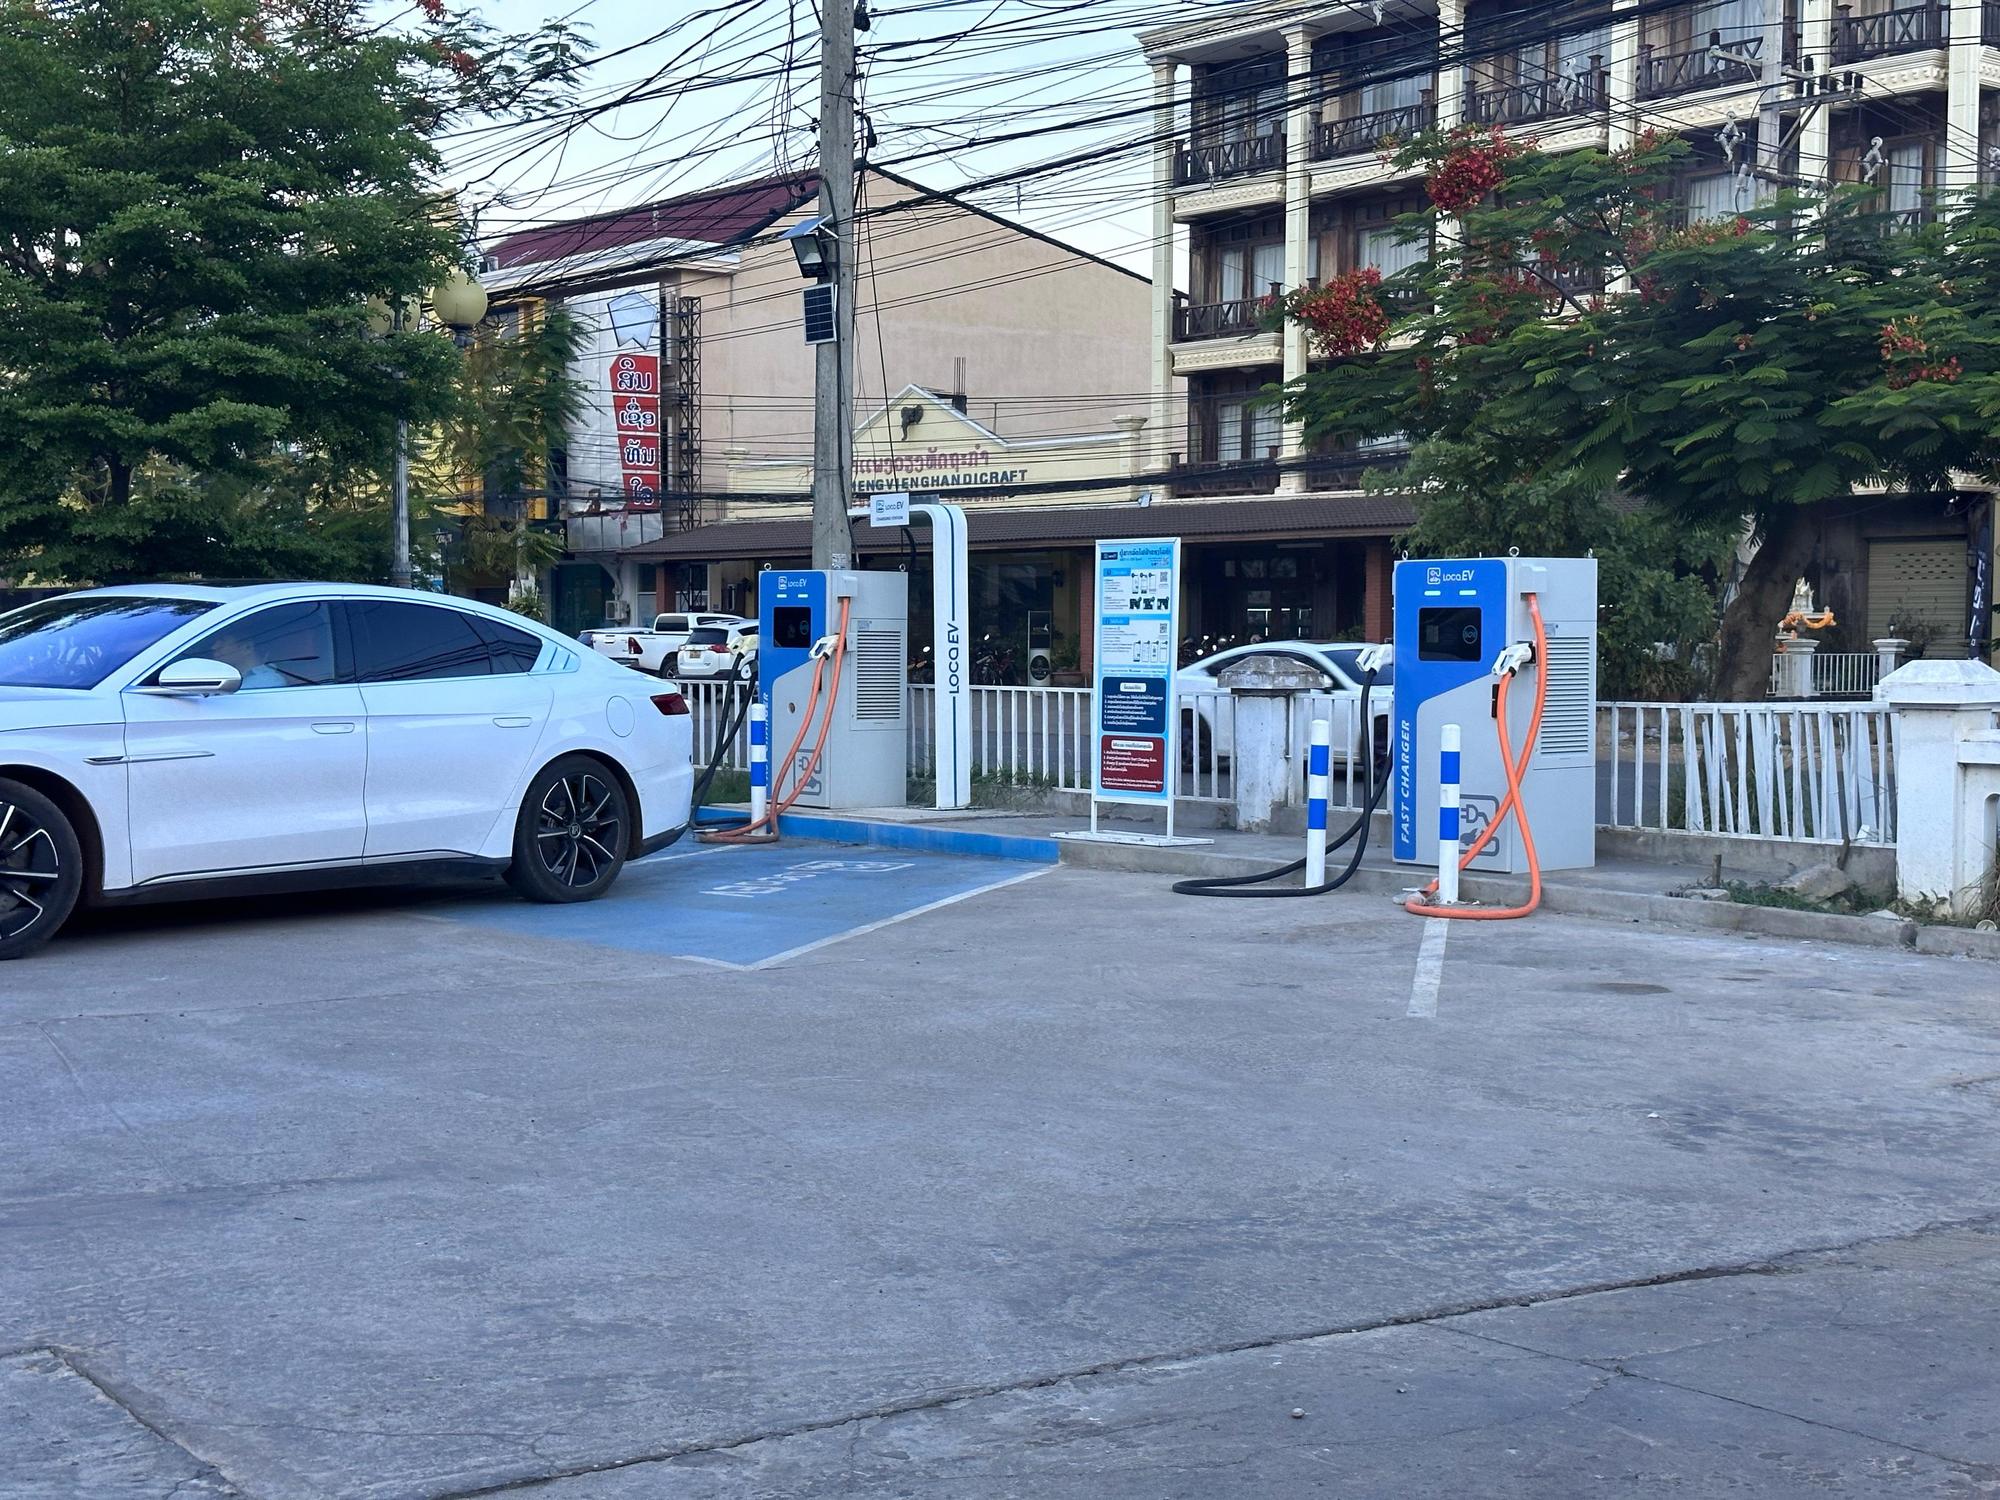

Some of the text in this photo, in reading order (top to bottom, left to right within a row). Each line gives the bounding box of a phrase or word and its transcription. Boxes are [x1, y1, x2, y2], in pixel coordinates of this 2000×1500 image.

[948, 622, 960, 694] LOCO EV
[1401, 719, 1410, 844] FAST CHARGER
